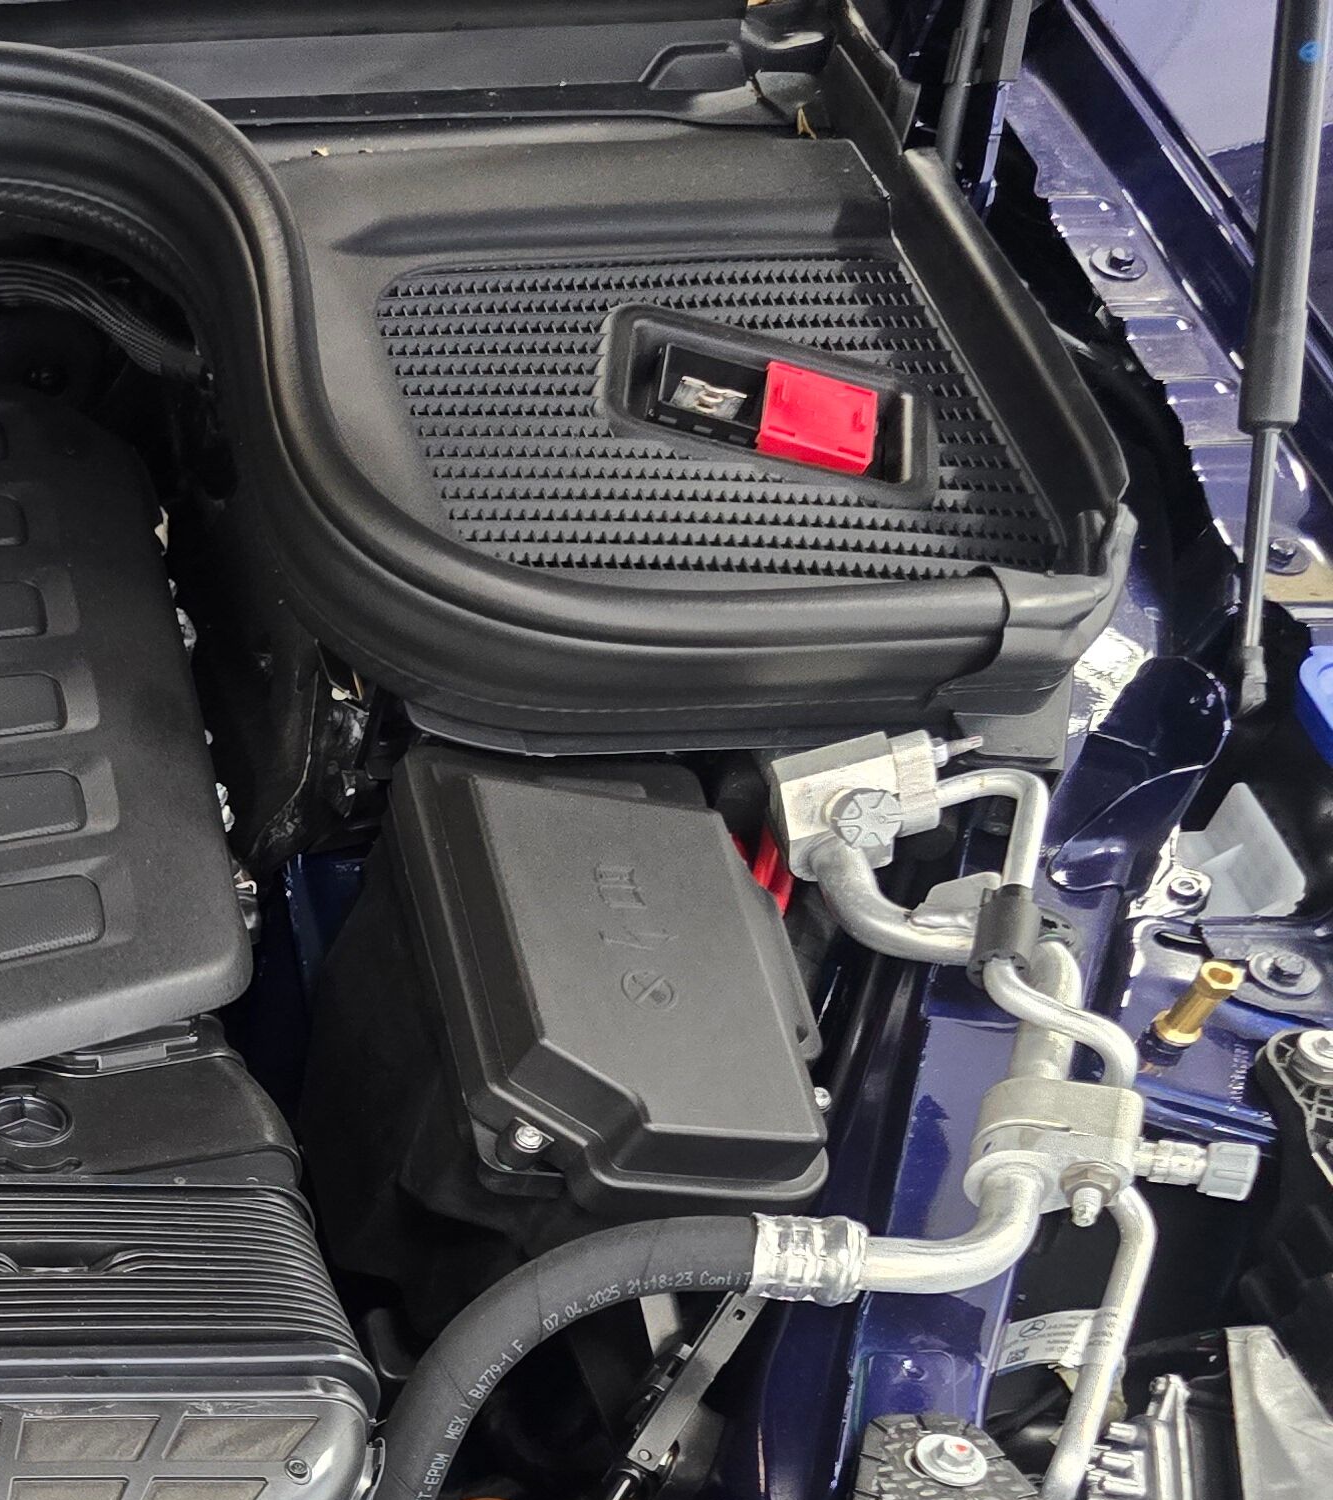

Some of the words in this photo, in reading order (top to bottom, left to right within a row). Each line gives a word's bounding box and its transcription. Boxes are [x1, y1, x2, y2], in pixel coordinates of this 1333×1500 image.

[444, 1415, 468, 1441] MEX
[468, 1352, 514, 1400] BA779-1
[542, 1284, 622, 1332] 07.04.2025
[626, 1271, 694, 1296] 21:18:23
